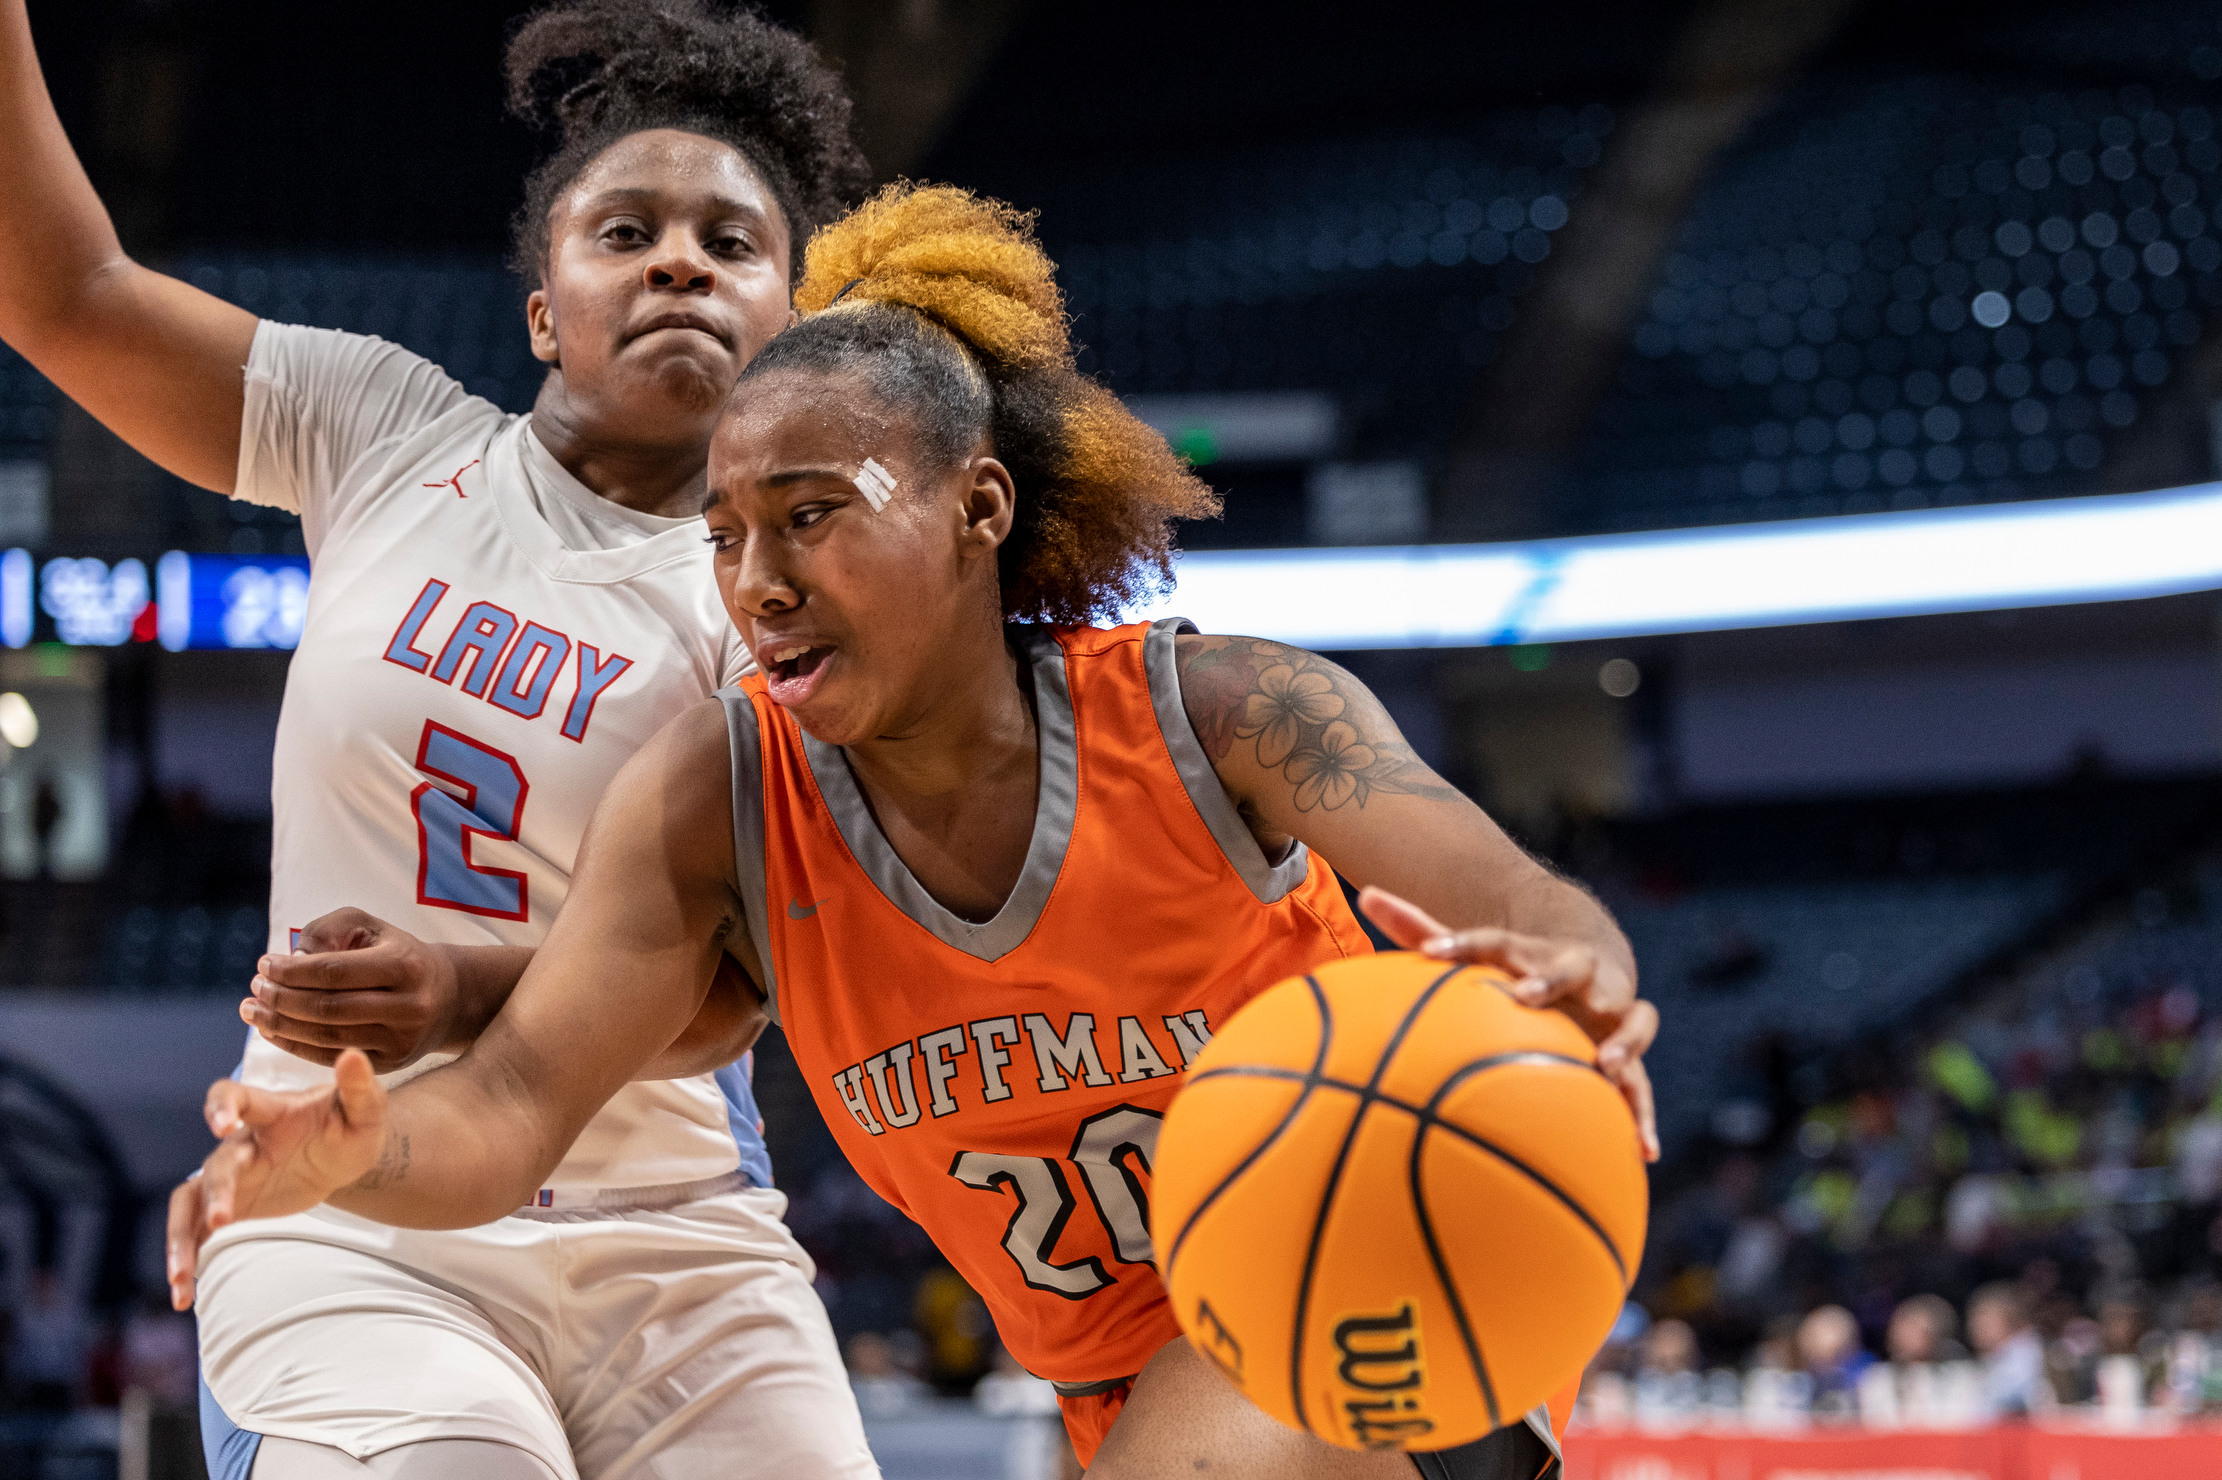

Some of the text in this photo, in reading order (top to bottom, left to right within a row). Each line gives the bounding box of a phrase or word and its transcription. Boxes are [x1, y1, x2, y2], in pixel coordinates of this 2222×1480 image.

[383, 577, 634, 744] LADY
[410, 718, 530, 922] 2
[832, 1010, 1213, 1136] HUFFMAN
[947, 1102, 1168, 1301] 20
